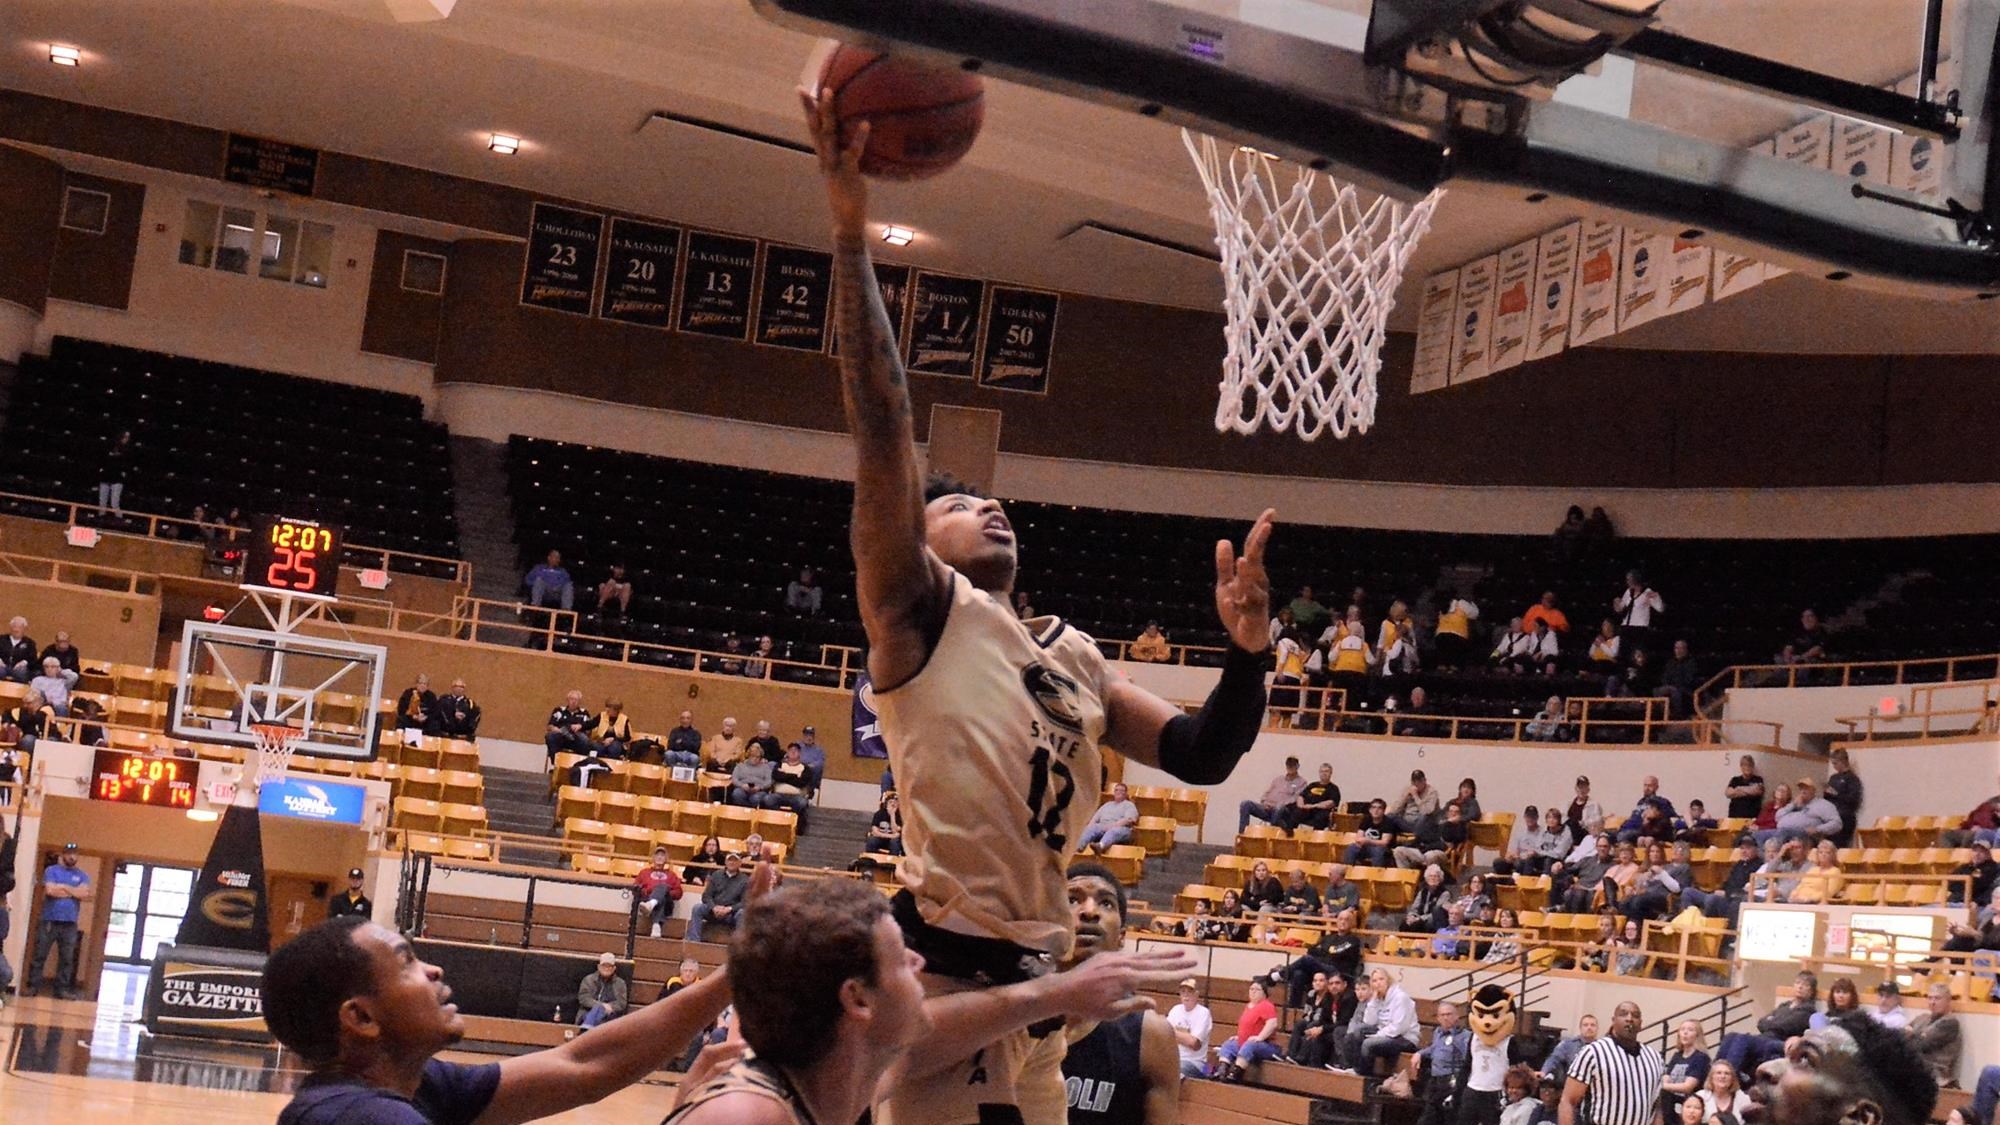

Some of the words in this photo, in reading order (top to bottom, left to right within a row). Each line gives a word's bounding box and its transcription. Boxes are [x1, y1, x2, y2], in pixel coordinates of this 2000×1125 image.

[548, 243, 577, 266] 23
[626, 258, 655, 281] 20
[780, 265, 816, 278] BLOSS
[705, 271, 732, 293] 13
[780, 284, 809, 306] 42
[928, 292, 969, 305] BOSTON
[1006, 324, 1034, 346] 50
[271, 524, 332, 552] 12:07
[267, 547, 317, 590] 25
[120, 607, 133, 624] 9
[688, 684, 699, 699] 8
[1417, 746, 1425, 758] 6
[1723, 753, 1731, 766] 5
[122, 758, 176, 781] 12:07
[100, 779, 121, 799] 13
[142, 784, 151, 802] 1
[171, 787, 192, 807] 14
[163, 979, 195, 990] THE
[200, 983, 260, 998] EMPORI
[1065, 1075, 1116, 1113] OLN
